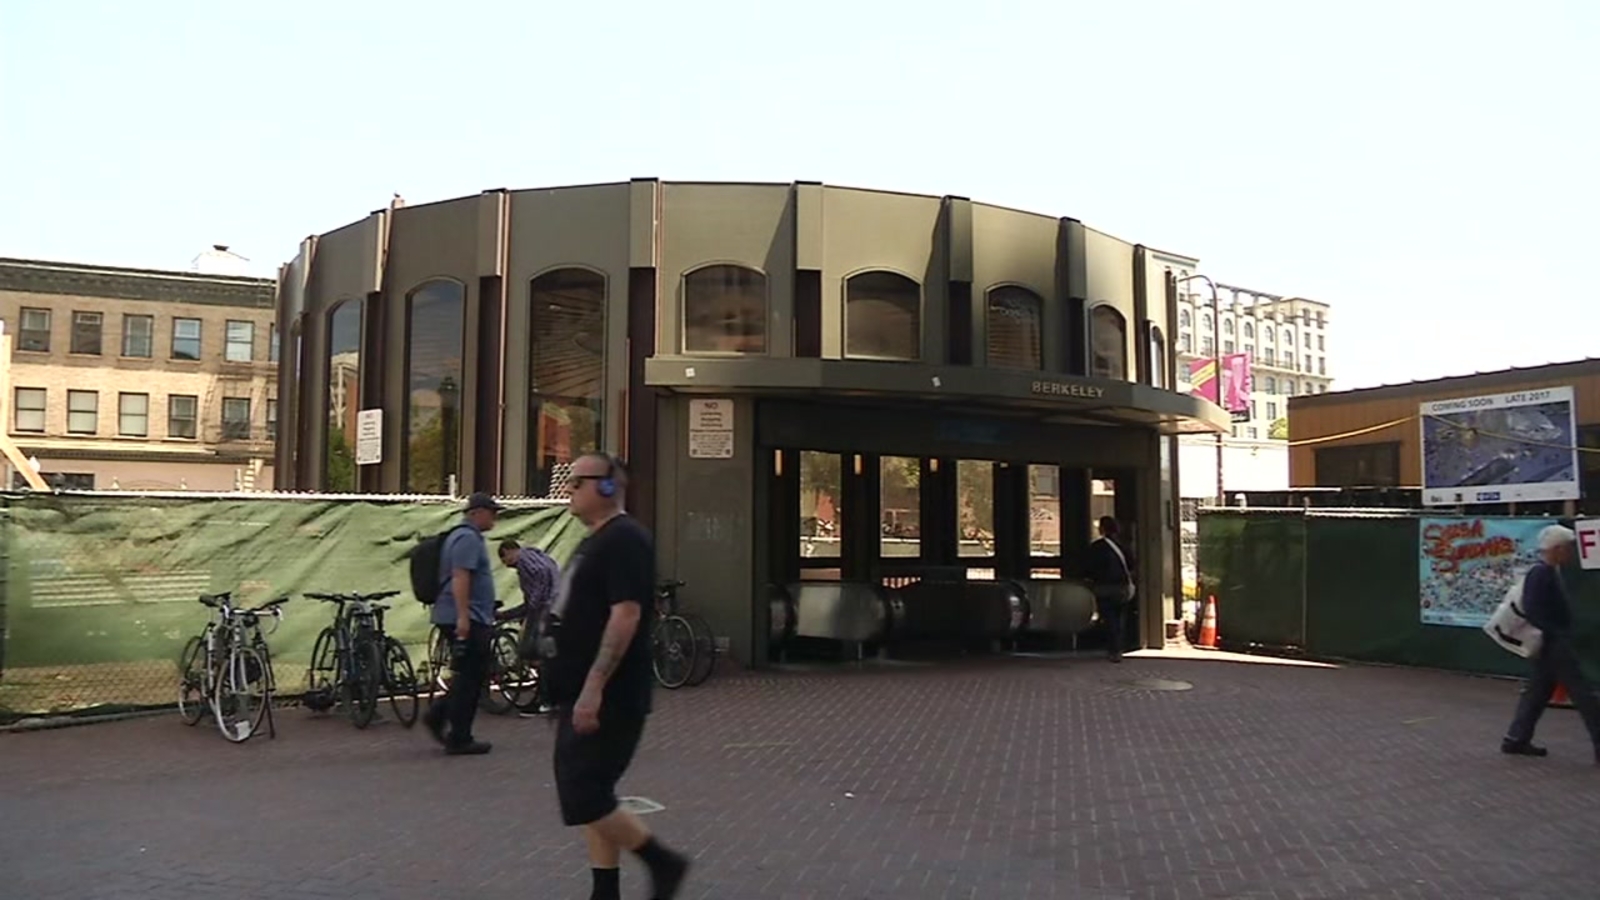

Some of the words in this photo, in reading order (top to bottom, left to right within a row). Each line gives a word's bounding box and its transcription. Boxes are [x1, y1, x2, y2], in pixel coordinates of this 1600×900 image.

[1031, 381, 1104, 398] BERKELEY
[704, 402, 719, 410] NO
[1431, 401, 1467, 412] COMING
[1468, 398, 1494, 408] SOON
[1505, 394, 1526, 404] LATE
[1528, 391, 1550, 401] 2017
[1579, 530, 1600, 559] F
